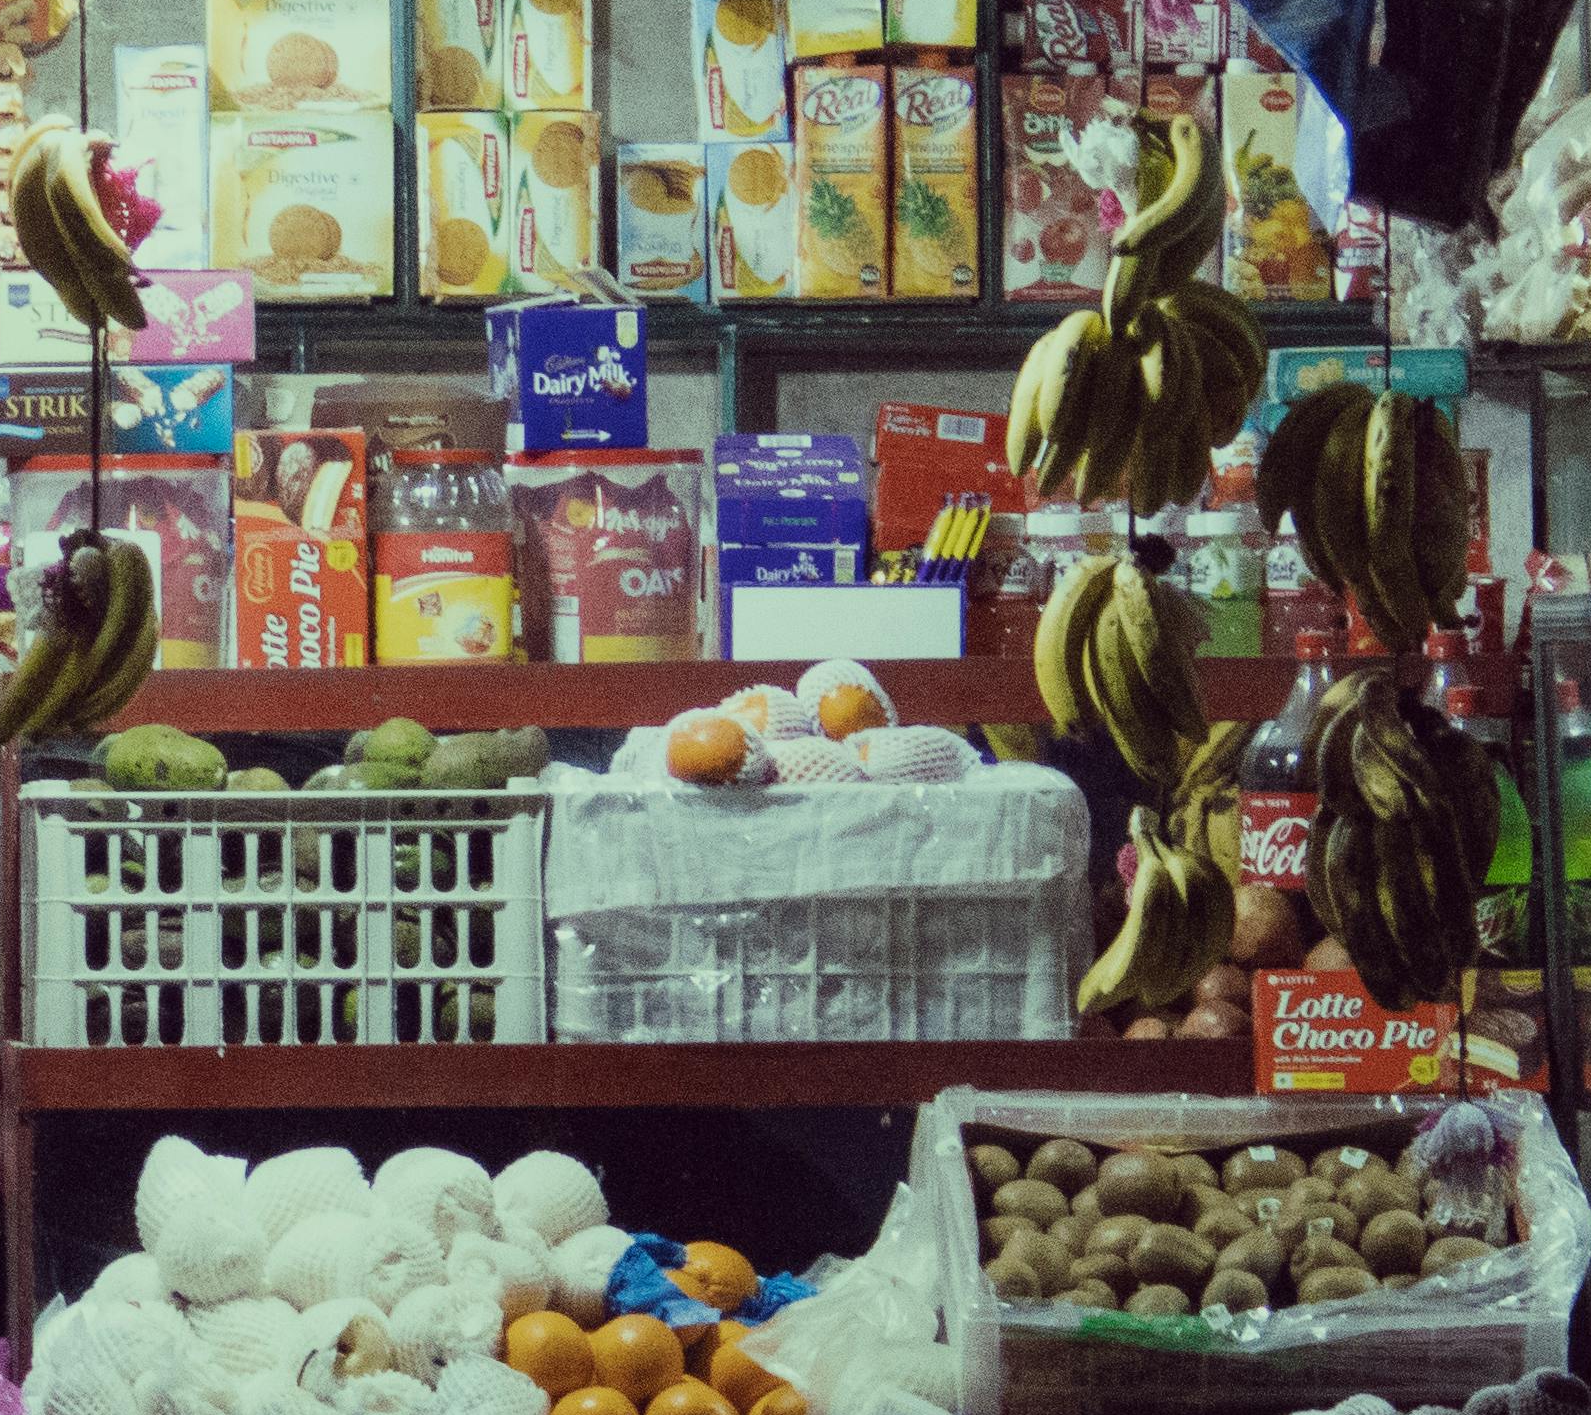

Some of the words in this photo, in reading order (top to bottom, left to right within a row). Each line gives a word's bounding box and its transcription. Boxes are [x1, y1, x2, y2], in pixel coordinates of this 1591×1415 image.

[815, 84, 875, 124] Real
[905, 85, 967, 123] Real
[268, 168, 339, 187] Digestive
[533, 371, 587, 397] Dairy
[589, 363, 638, 392] Milk
[290, 542, 321, 601] Pie
[755, 566, 790, 583] Dairy
[792, 562, 823, 580] Milk
[261, 614, 289, 669] otte
[1275, 991, 1363, 1020] Lotte
[1273, 1022, 1375, 1051] Choco
[1380, 1021, 1437, 1050] Pie
